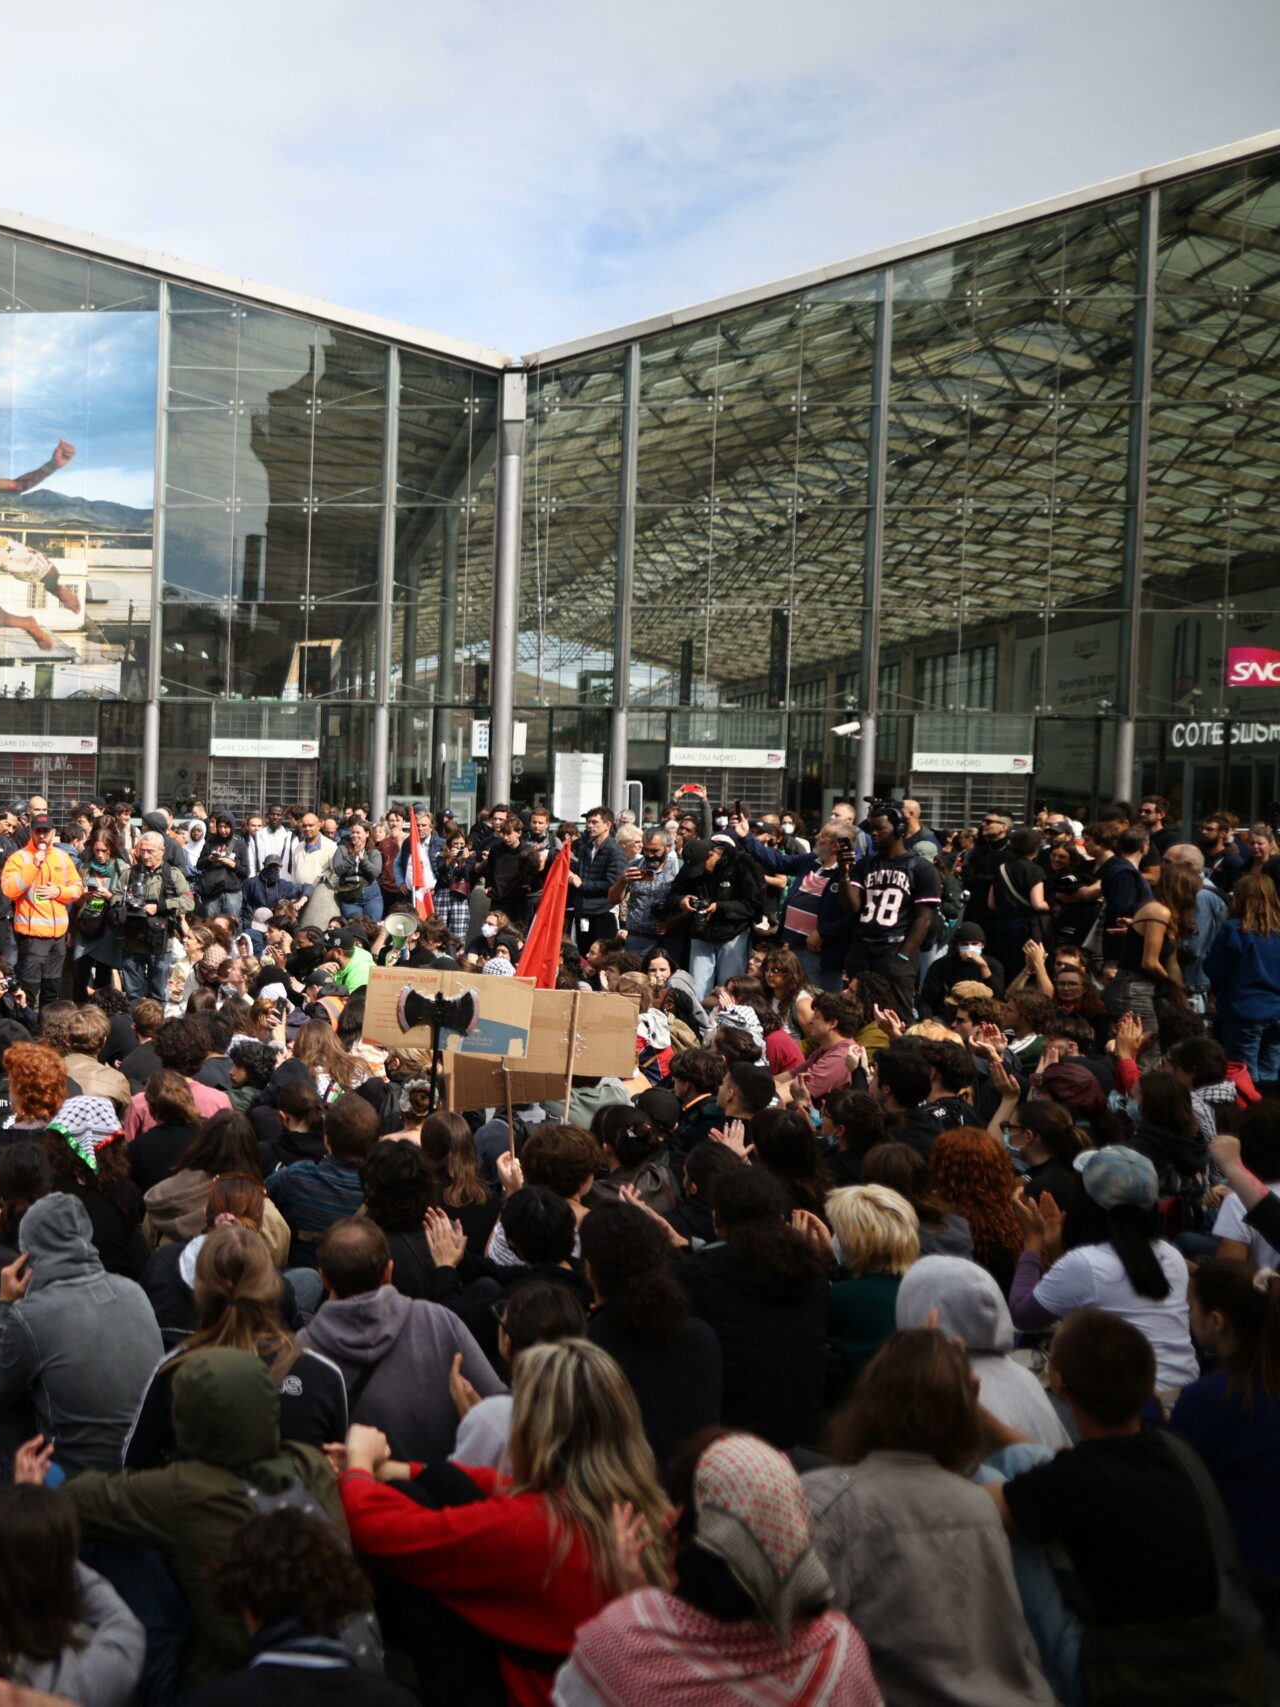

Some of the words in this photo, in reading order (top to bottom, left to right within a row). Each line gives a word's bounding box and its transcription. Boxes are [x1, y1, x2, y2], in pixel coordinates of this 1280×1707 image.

[1230, 662, 1280, 681] SNC
[1171, 721, 1224, 747] COTE
[31, 740, 54, 748] NORD
[712, 754, 737, 762] NORD
[917, 758, 938, 766] GARE
[941, 758, 954, 766] DU
[956, 759, 982, 767] NORD
[860, 887, 904, 927] 58
